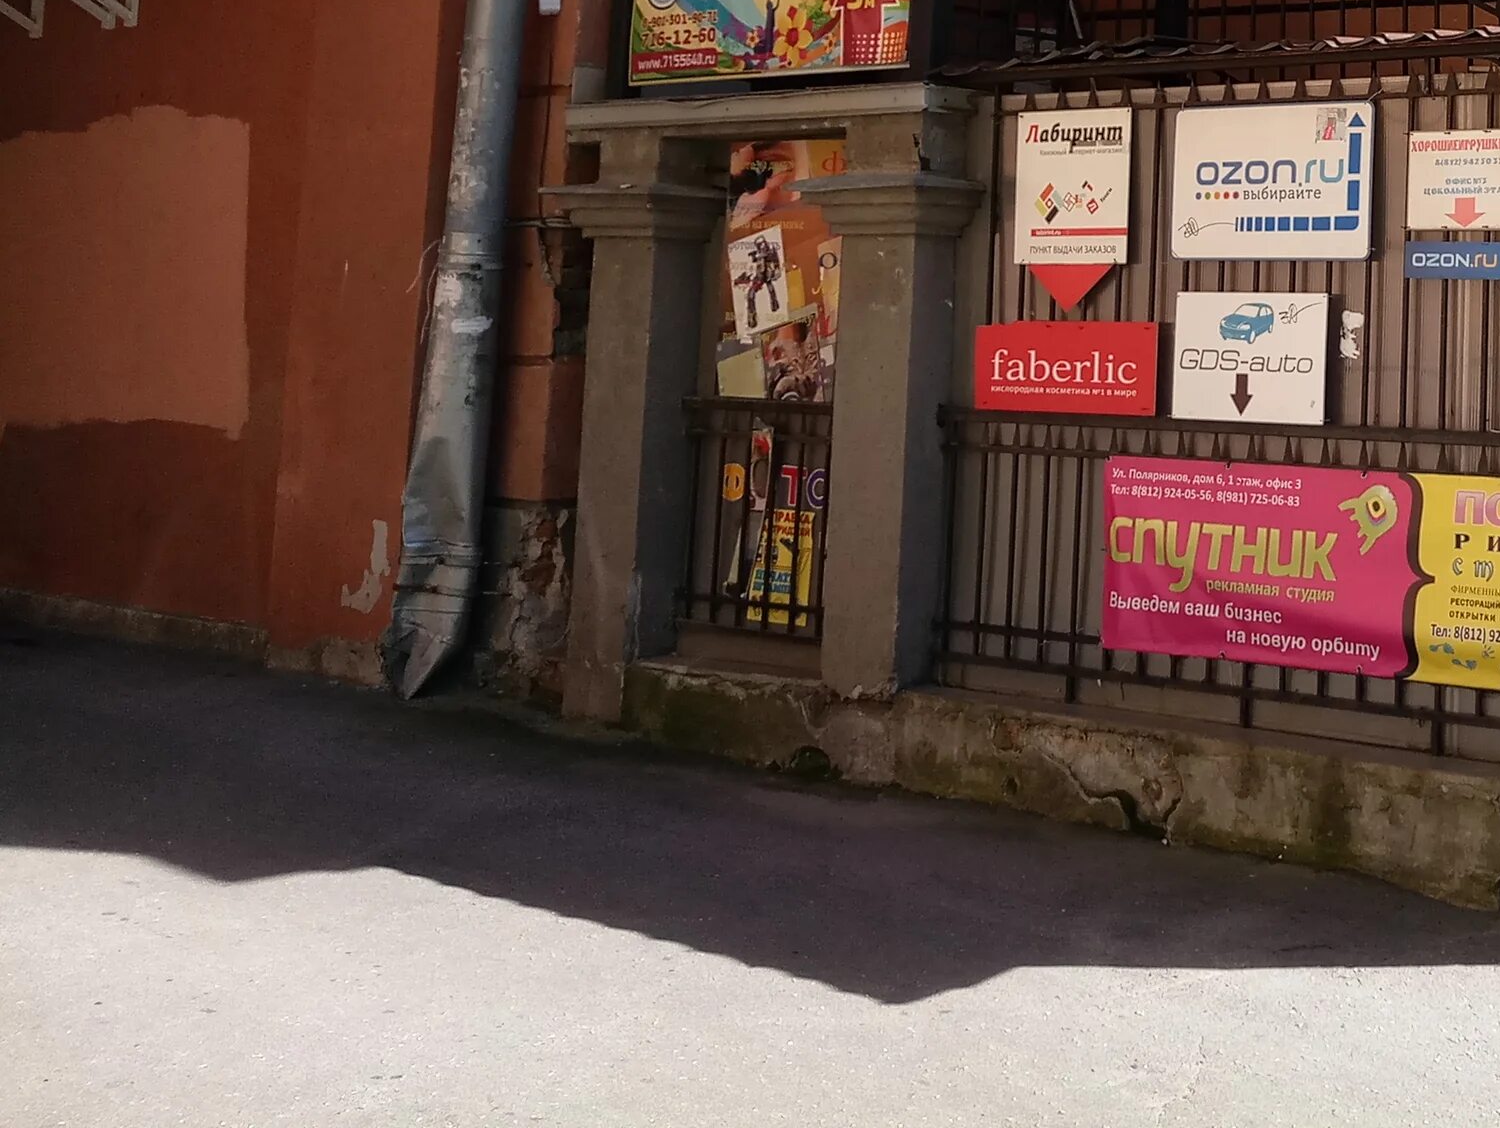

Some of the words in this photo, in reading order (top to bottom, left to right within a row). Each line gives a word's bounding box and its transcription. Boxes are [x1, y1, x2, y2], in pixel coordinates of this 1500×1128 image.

[1025, 122, 1123, 153] Лабиринт
[1196, 158, 1344, 187] ozon.ru
[1423, 185, 1483, 195] ЦОКОЛЬНЫЙ
[1029, 245, 1052, 254] ПУНКТ
[1053, 245, 1083, 255] ВЫДАЧИ
[1084, 244, 1117, 254] ЗАКАЗОВ
[1411, 252, 1498, 268] OZON.ru
[991, 348, 1138, 384] faberlic
[1179, 348, 1314, 374] GDS-auto
[991, 385, 1045, 394] кислородная
[1046, 386, 1091, 396] косметика
[1114, 389, 1137, 398] мире
[1112, 467, 1126, 479] Ул.
[1129, 469, 1192, 484] Полярников,
[1193, 473, 1215, 486] дом
[1216, 474, 1227, 486] 6,
[1228, 475, 1235, 486] 1
[1236, 477, 1265, 490] этаж,
[1266, 478, 1294, 492] офис
[1295, 479, 1302, 490] 3
[1110, 484, 1130, 497] Тел:
[1131, 485, 1163, 500] 8(812)
[1164, 487, 1215, 504] 924-05-56,
[1216, 490, 1248, 505] 8(981)
[1250, 493, 1300, 508] 725-06-83
[1206, 578, 1280, 597] рекламная
[1286, 586, 1335, 603] студия
[1110, 591, 1180, 615] Выведем
[1184, 600, 1220, 618] ваш
[1224, 602, 1282, 624] бизнес
[1450, 598, 1500, 609] РЕСТОРАЦИЙ
[1449, 611, 1496, 622] ОТКРЫТКИ
[1226, 629, 1246, 644] на
[1251, 632, 1306, 651] новую
[1311, 636, 1380, 661] орбиту
[1431, 624, 1452, 638] Тел:
[1453, 625, 1487, 644] 8(812)
